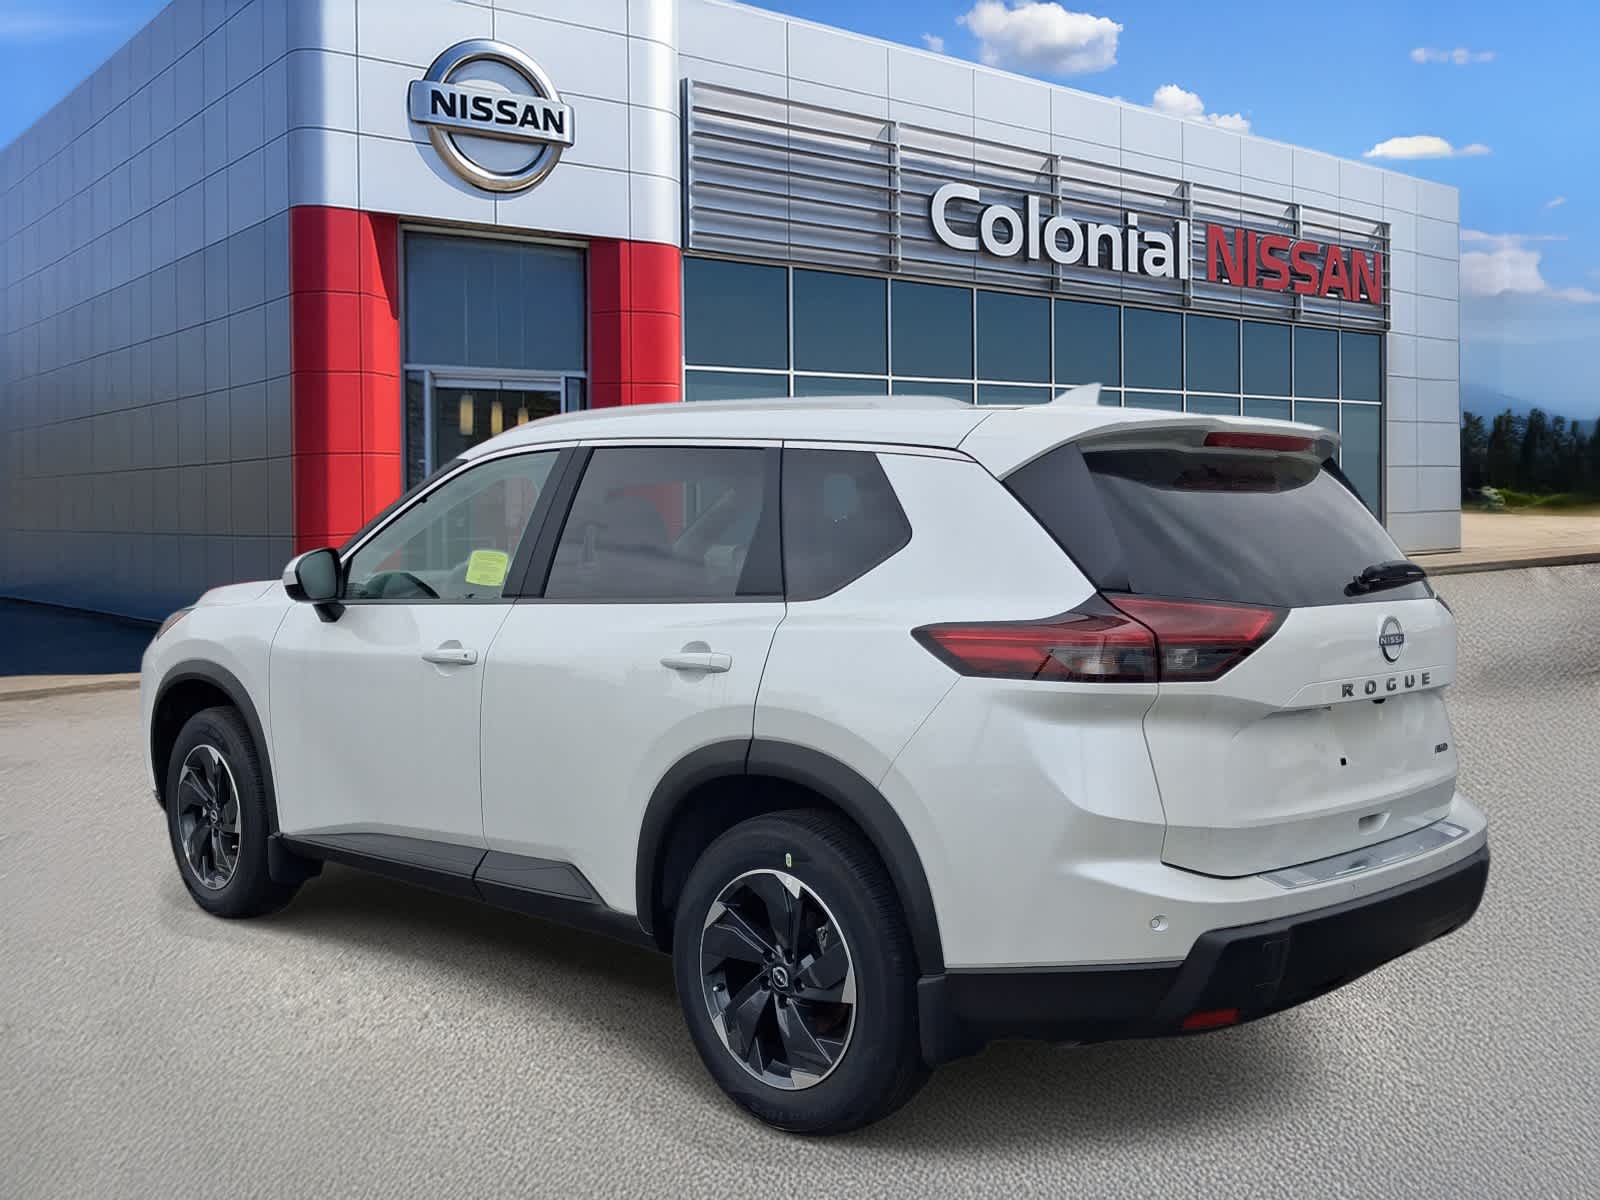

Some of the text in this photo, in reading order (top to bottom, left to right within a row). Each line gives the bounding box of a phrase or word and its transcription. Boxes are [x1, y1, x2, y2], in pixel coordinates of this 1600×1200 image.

[431, 89, 564, 134] NISSAN
[931, 183, 1382, 304] Colonial NISSAN
[1380, 634, 1402, 645] NISS
[1341, 673, 1431, 698] ROGUE
